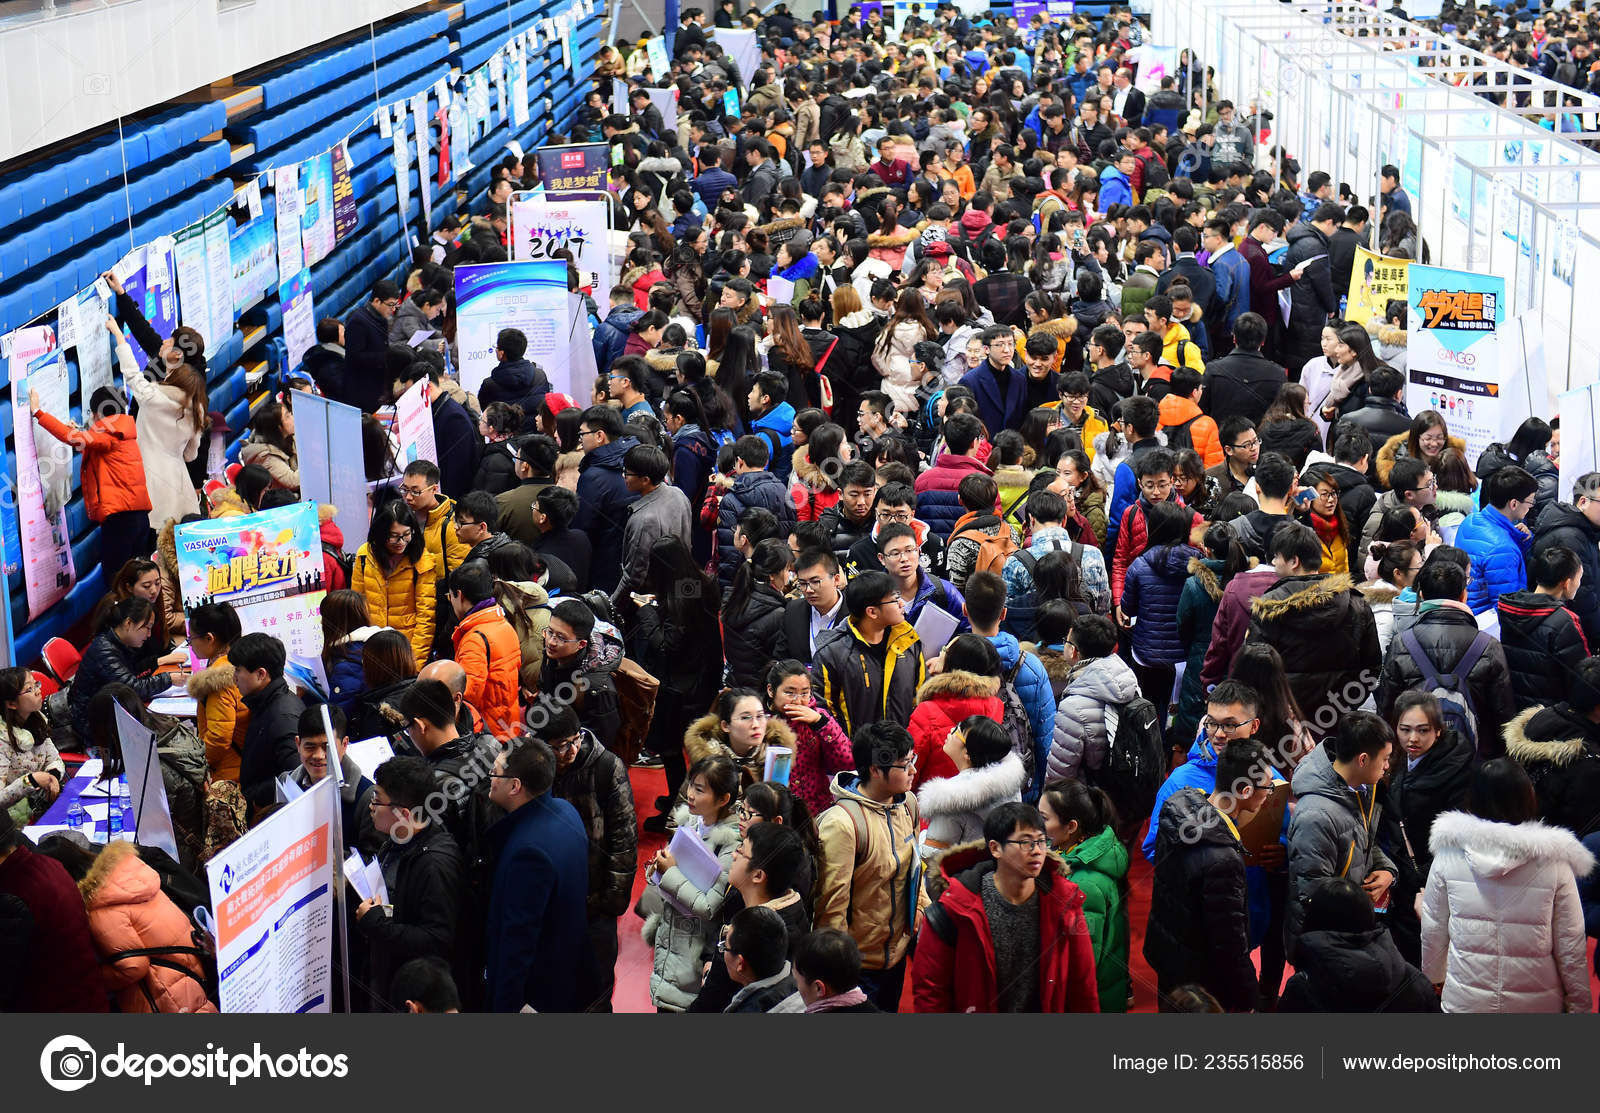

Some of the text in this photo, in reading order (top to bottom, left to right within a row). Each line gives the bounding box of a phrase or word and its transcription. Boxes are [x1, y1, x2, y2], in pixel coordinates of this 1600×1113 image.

[467, 350, 488, 361] 2007
[1459, 383, 1475, 391] About
[184, 536, 228, 552] YASKAWA
[208, 551, 297, 590] 诚聘英才
[286, 611, 302, 622] 学历
